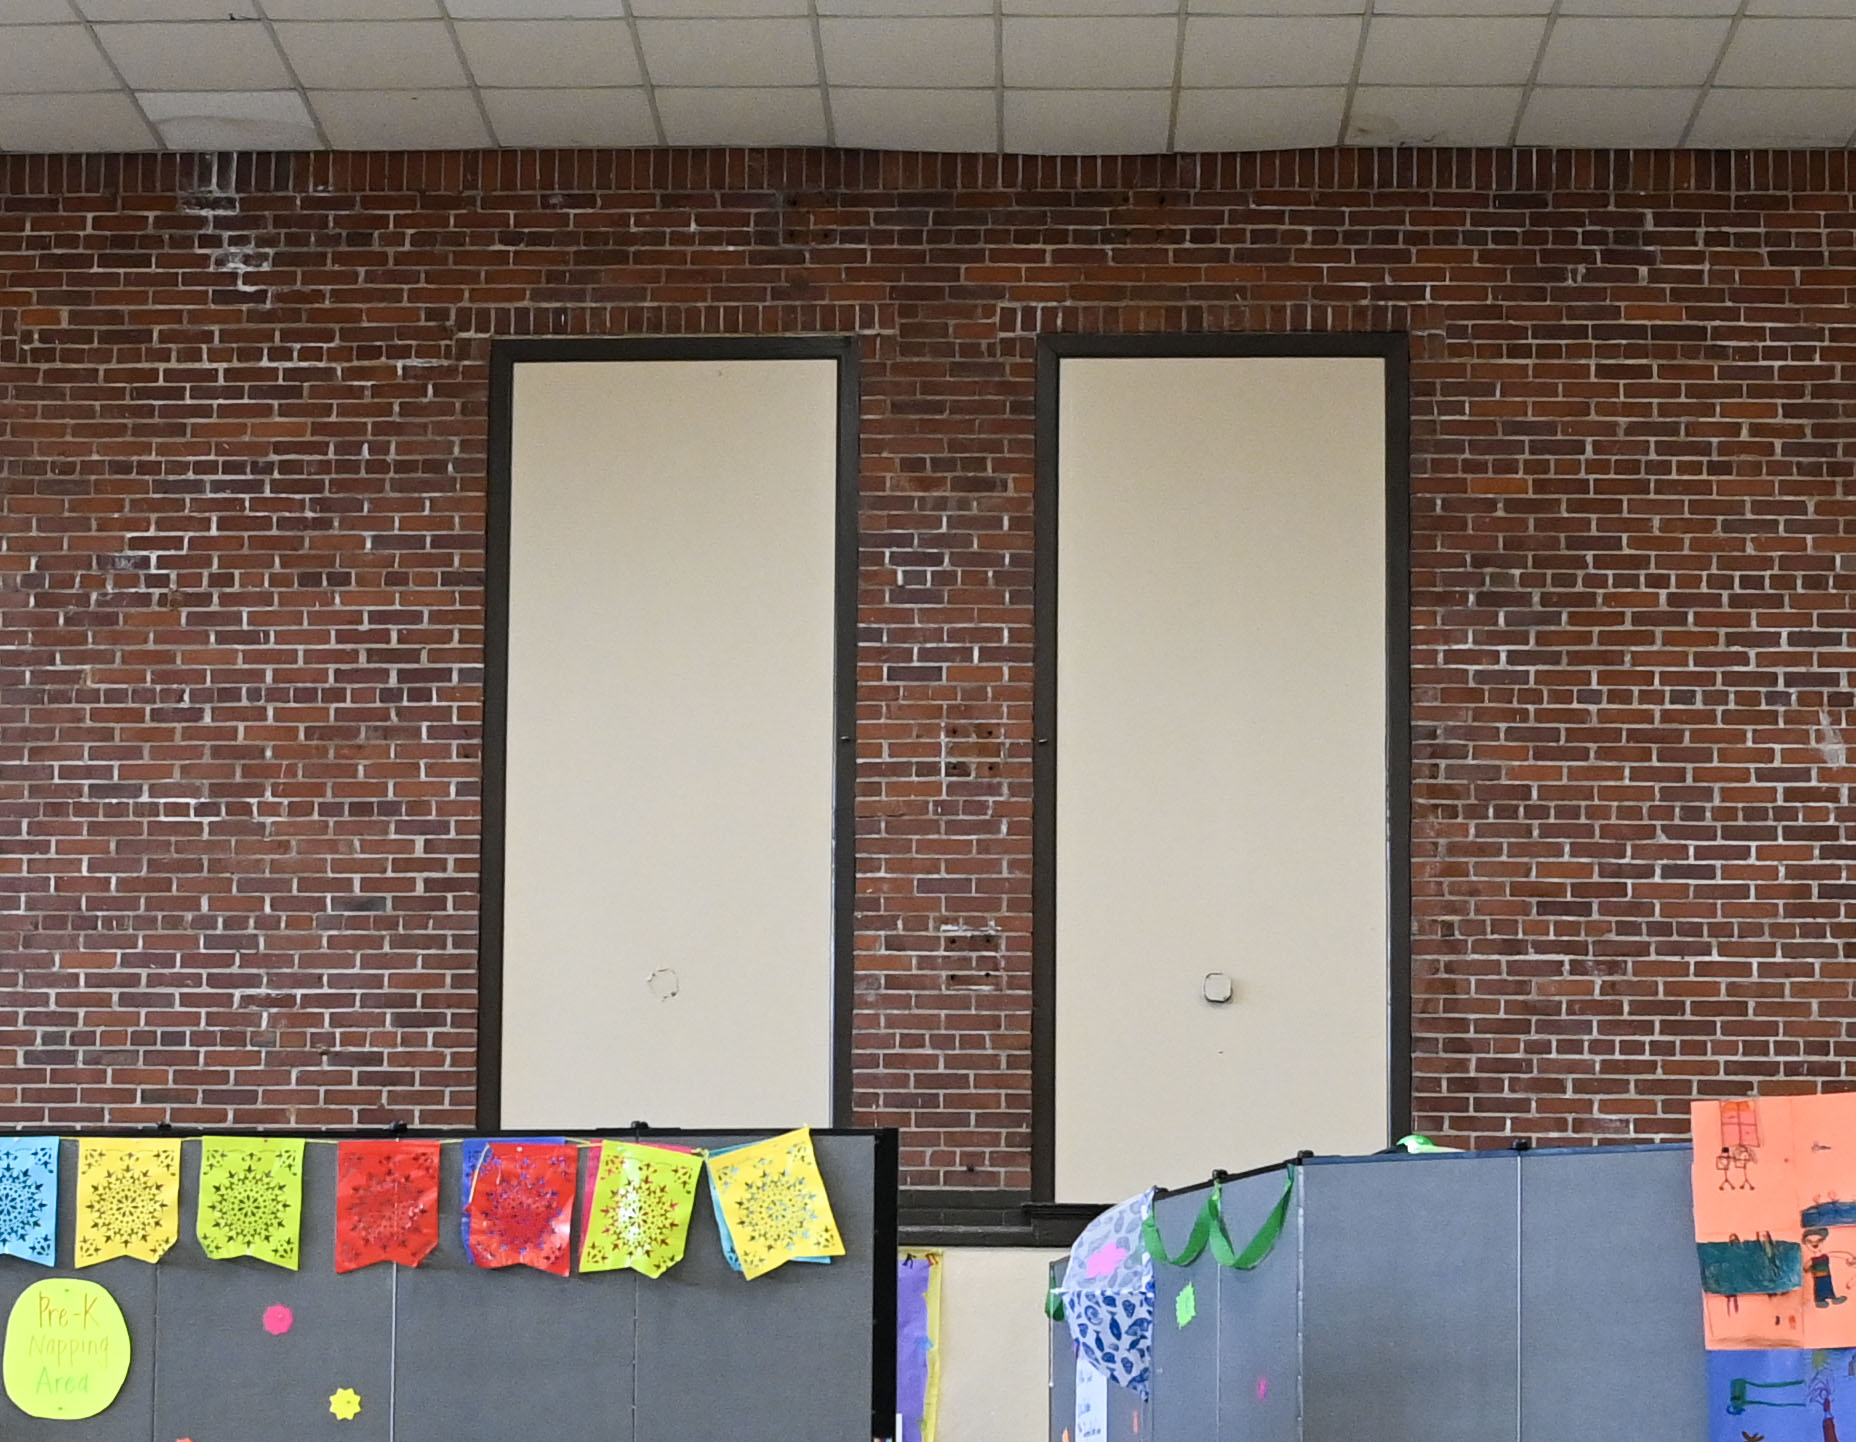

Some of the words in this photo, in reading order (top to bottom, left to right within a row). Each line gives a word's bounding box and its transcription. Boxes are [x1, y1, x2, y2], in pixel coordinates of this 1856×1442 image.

[38, 1291, 100, 1329] Pre-K
[27, 1335, 110, 1369] Napping
[35, 1366, 90, 1395] Area
